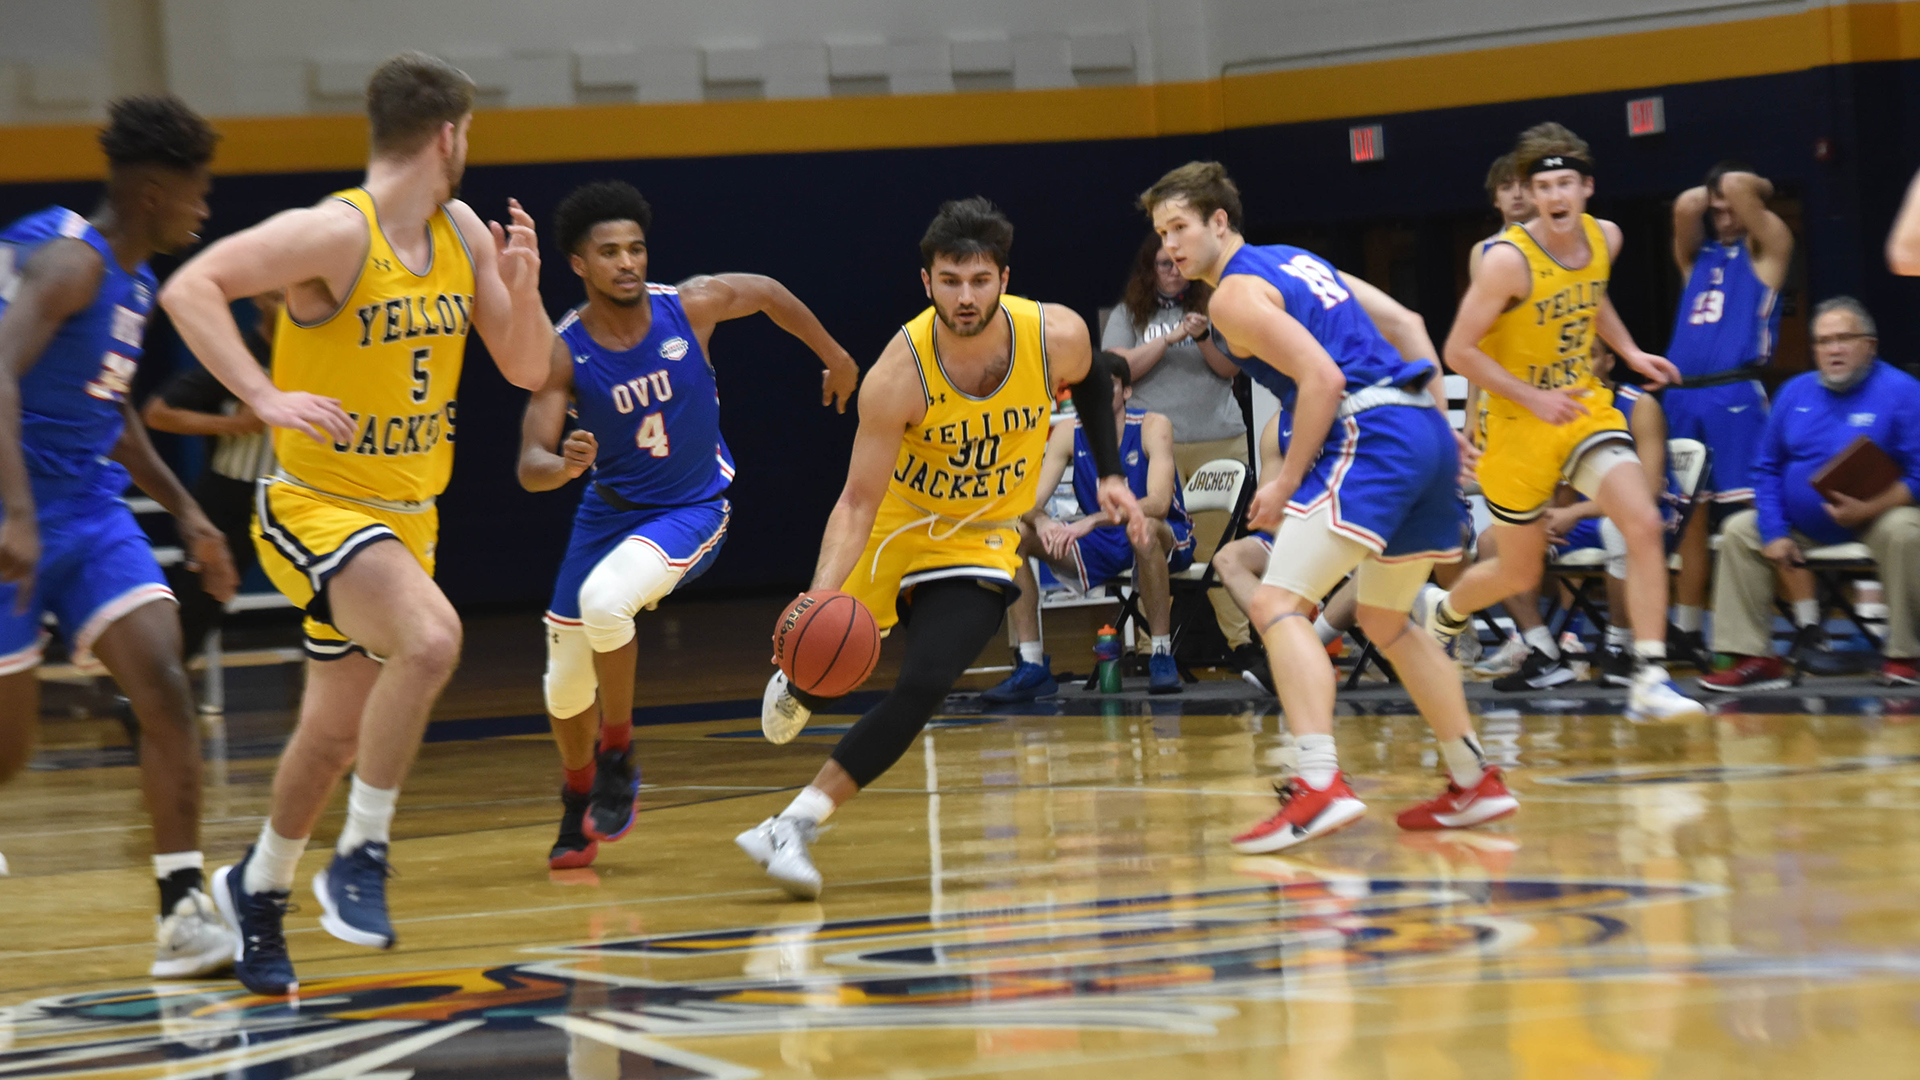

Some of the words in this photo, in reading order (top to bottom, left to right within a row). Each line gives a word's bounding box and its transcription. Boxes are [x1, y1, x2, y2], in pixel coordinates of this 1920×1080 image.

[1354, 127, 1374, 161] EXIT
[1535, 279, 1608, 326] YELLO
[410, 346, 433, 405] 5
[611, 369, 674, 415] OVU
[333, 399, 458, 457] JACKS
[635, 410, 670, 458] 4
[923, 406, 1045, 443] YELLOW
[893, 453, 1027, 500] JACKETS
[948, 433, 1001, 473] 30
[1187, 470, 1240, 492] JACKETS
[777, 597, 818, 660] Wilson
